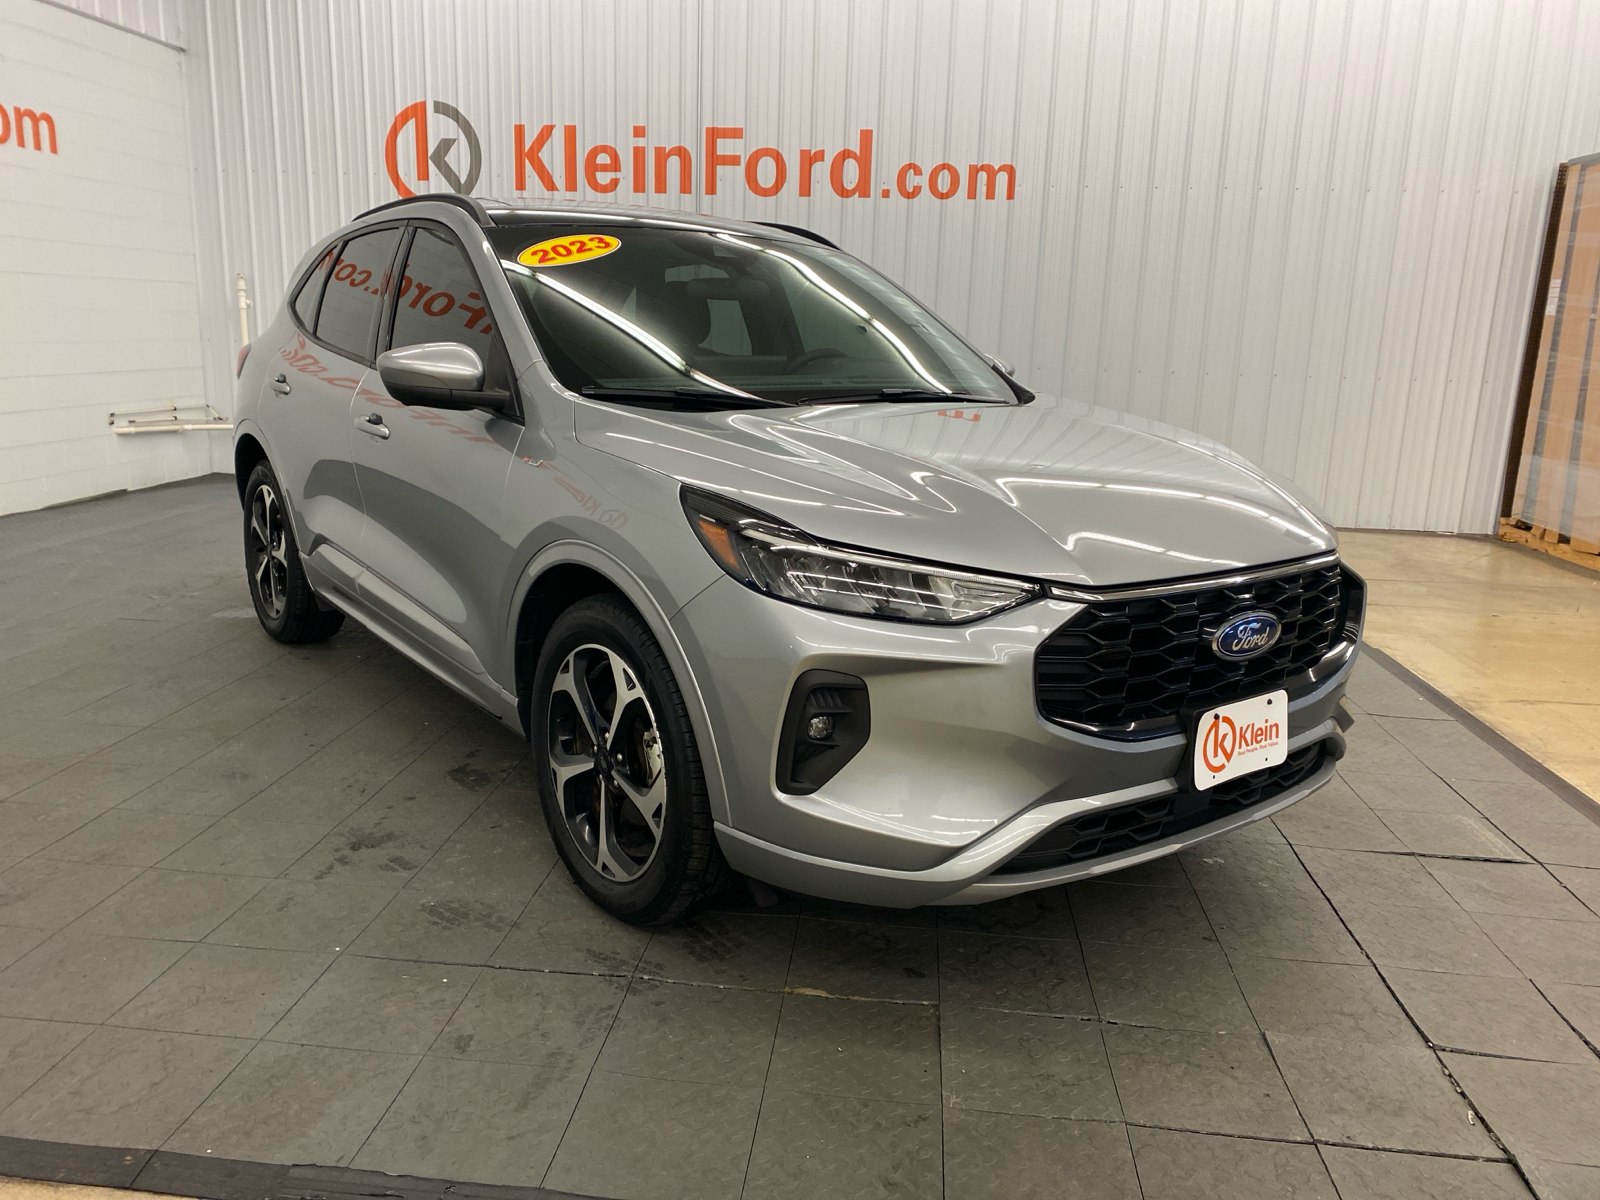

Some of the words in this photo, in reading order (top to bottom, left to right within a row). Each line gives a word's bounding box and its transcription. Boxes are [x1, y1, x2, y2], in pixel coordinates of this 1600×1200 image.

[514, 123, 1016, 200] KleinFord.com
[531, 236, 612, 264] 2023
[1232, 622, 1270, 651] Ford
[1238, 718, 1279, 750] Klein
